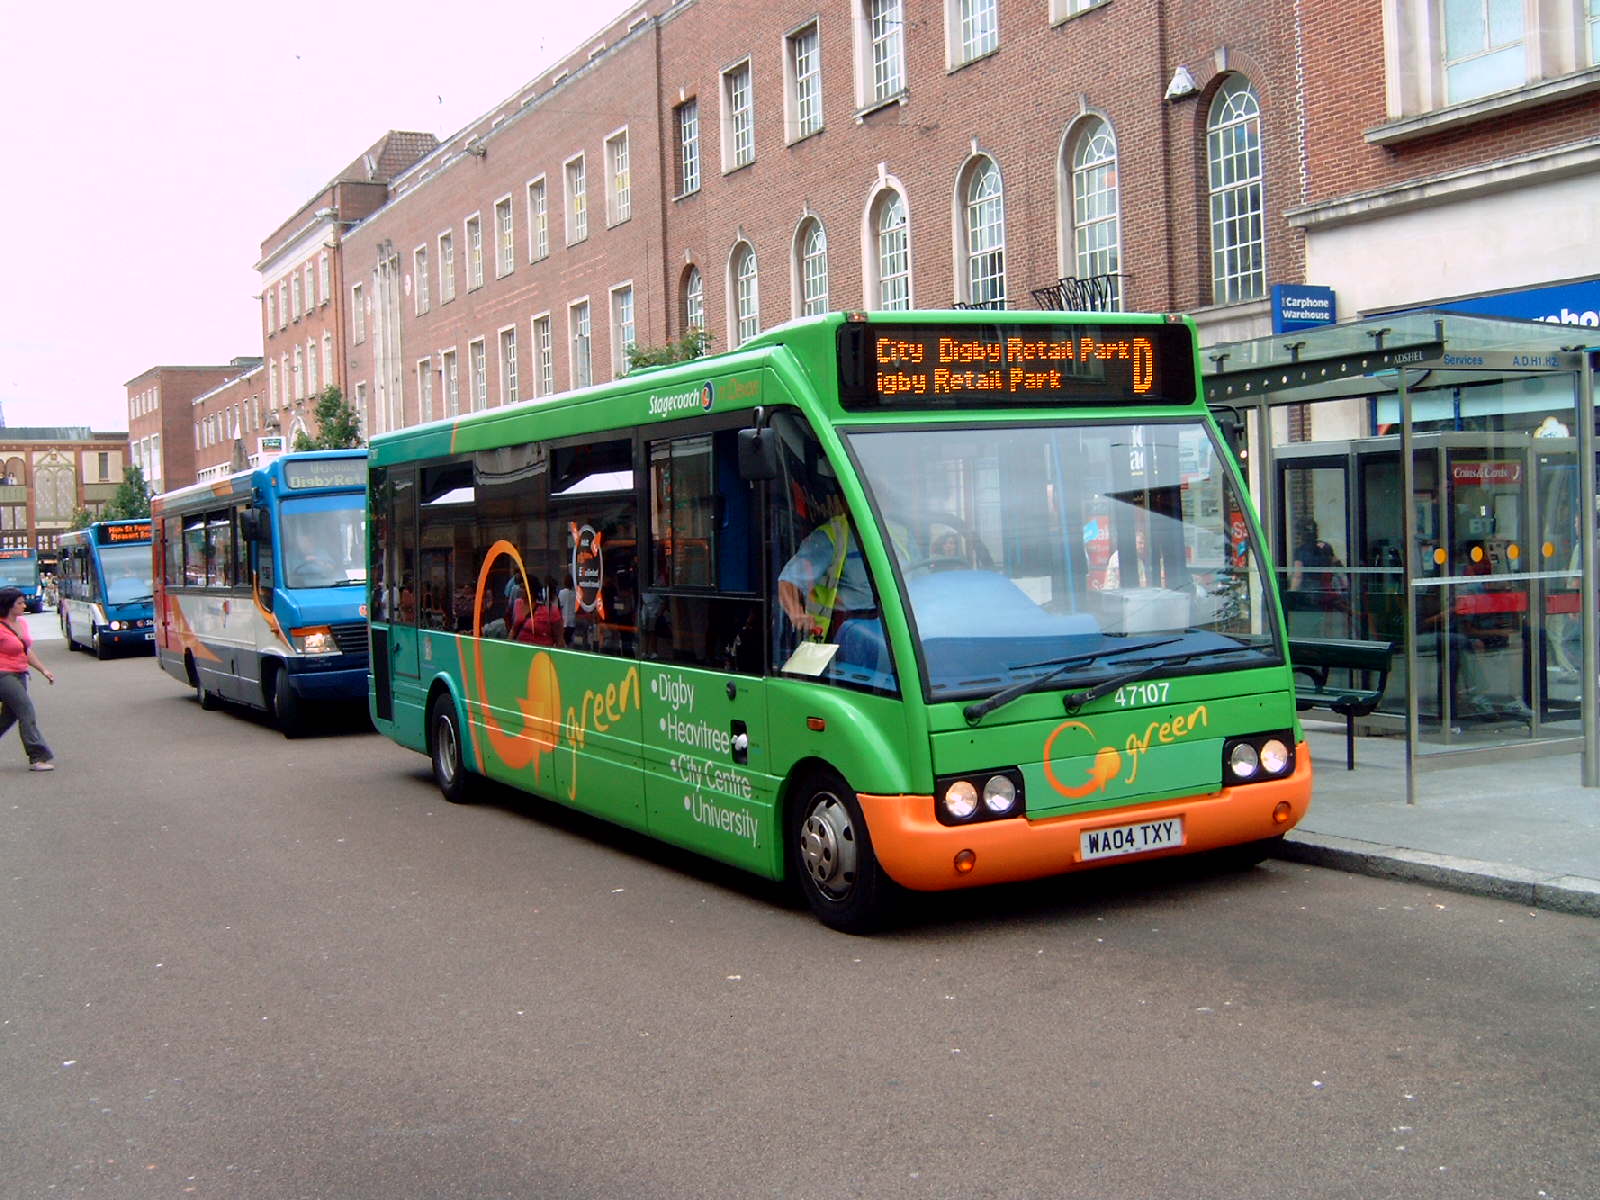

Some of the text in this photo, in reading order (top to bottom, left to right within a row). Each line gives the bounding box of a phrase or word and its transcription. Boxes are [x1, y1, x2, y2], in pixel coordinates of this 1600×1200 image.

[1282, 310, 1330, 320] Warehouse
[1286, 297, 1329, 309] Carphone
[876, 337, 1131, 363] City Digby Retail Park
[1132, 337, 1153, 393] D
[1443, 353, 1485, 366] Services
[934, 368, 1003, 393] Retail
[1009, 368, 1063, 392] Park
[648, 388, 700, 418] Stagecoach
[659, 674, 695, 713] Digby
[1114, 682, 1170, 706] 47107
[566, 665, 640, 800] green
[667, 712, 731, 755] Heavitree
[1125, 704, 1208, 784] green
[677, 755, 752, 799] City Centre
[692, 793, 759, 848] University
[1088, 821, 1173, 854] WA04 TXY
